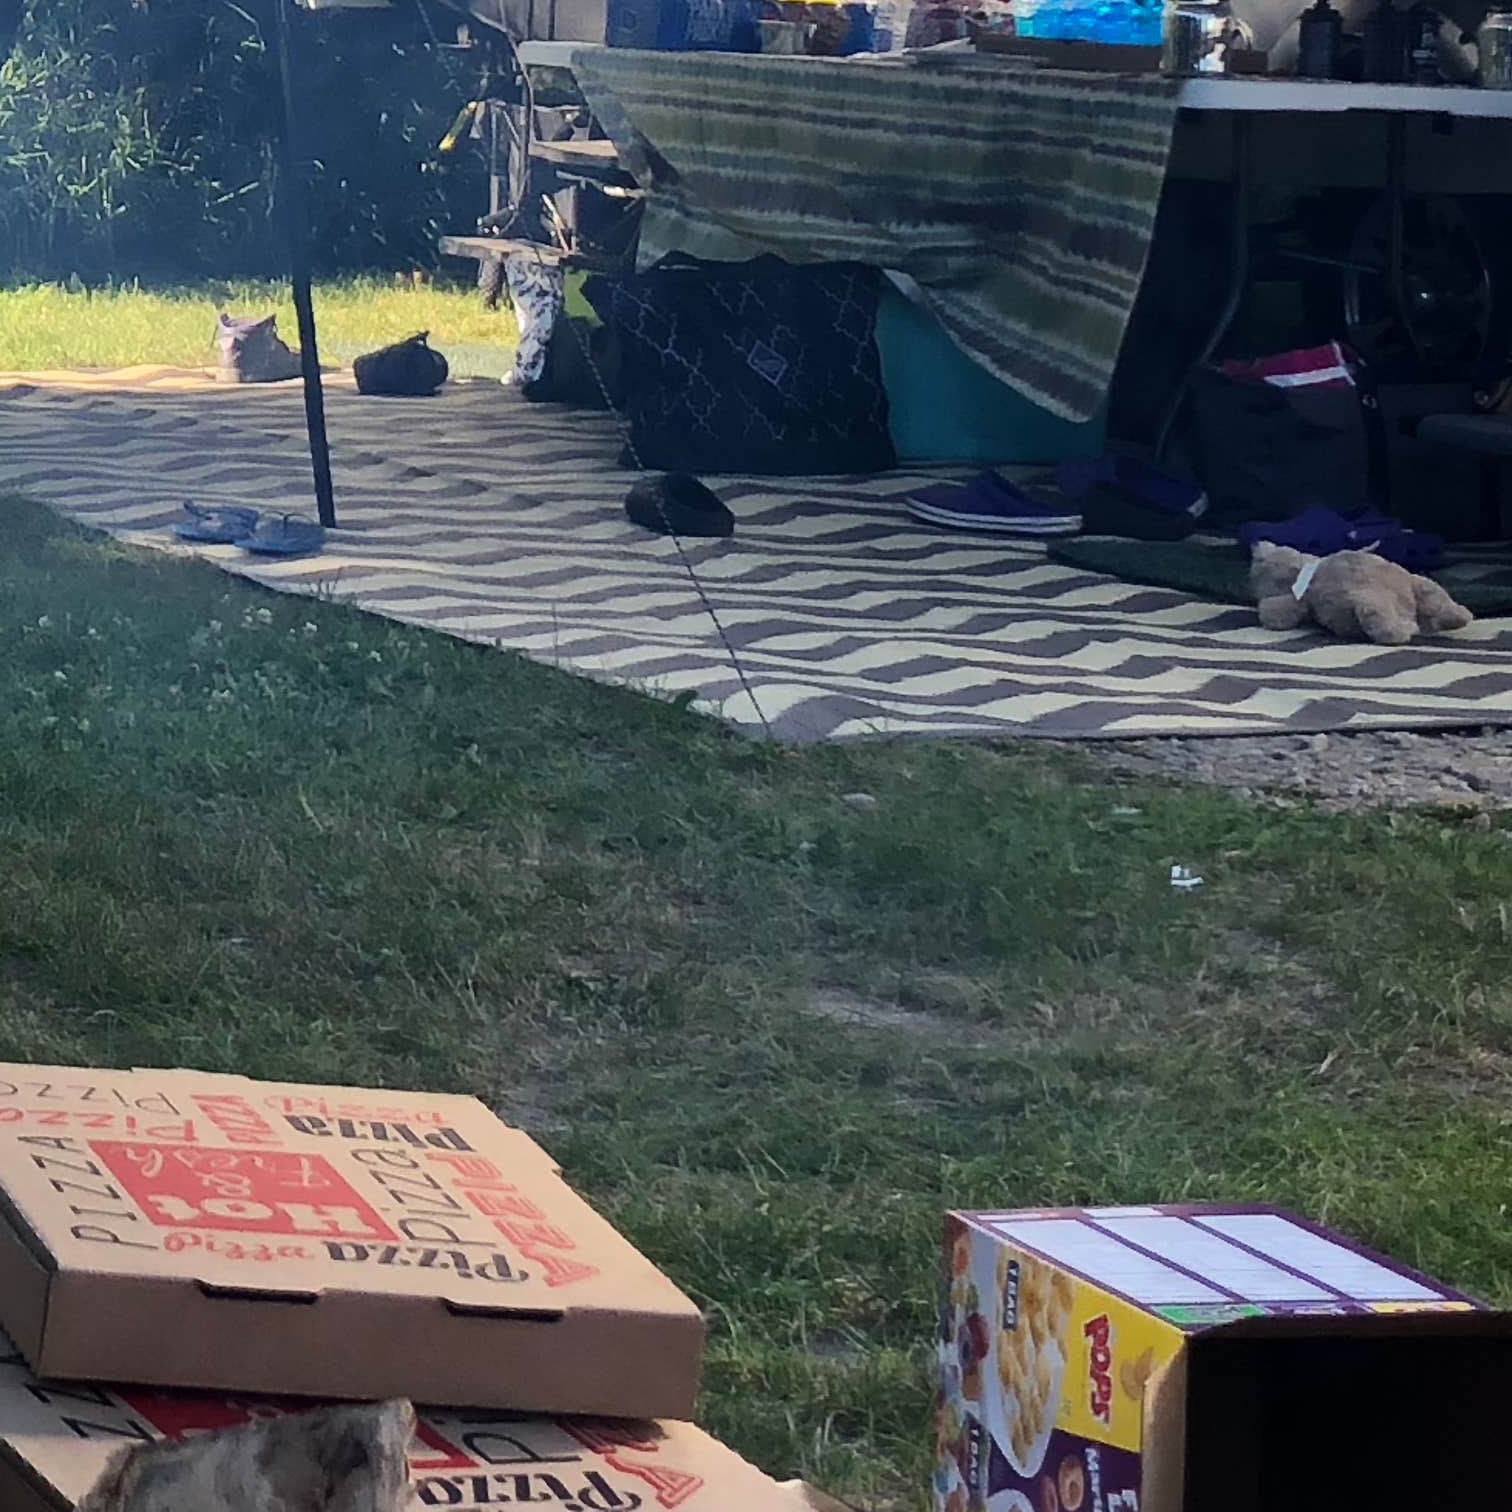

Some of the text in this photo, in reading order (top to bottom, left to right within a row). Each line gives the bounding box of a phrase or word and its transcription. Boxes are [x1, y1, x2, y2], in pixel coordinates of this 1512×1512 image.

[125, 1147, 331, 1187] Fresh
[193, 1170, 252, 1198] &
[17, 1136, 159, 1250] PIZZA
[426, 1152, 601, 1287] PIZZA
[322, 1241, 530, 1283] Pizza
[1006, 1283, 1018, 1324] BAG
[417, 1471, 642, 1512] Pizza
